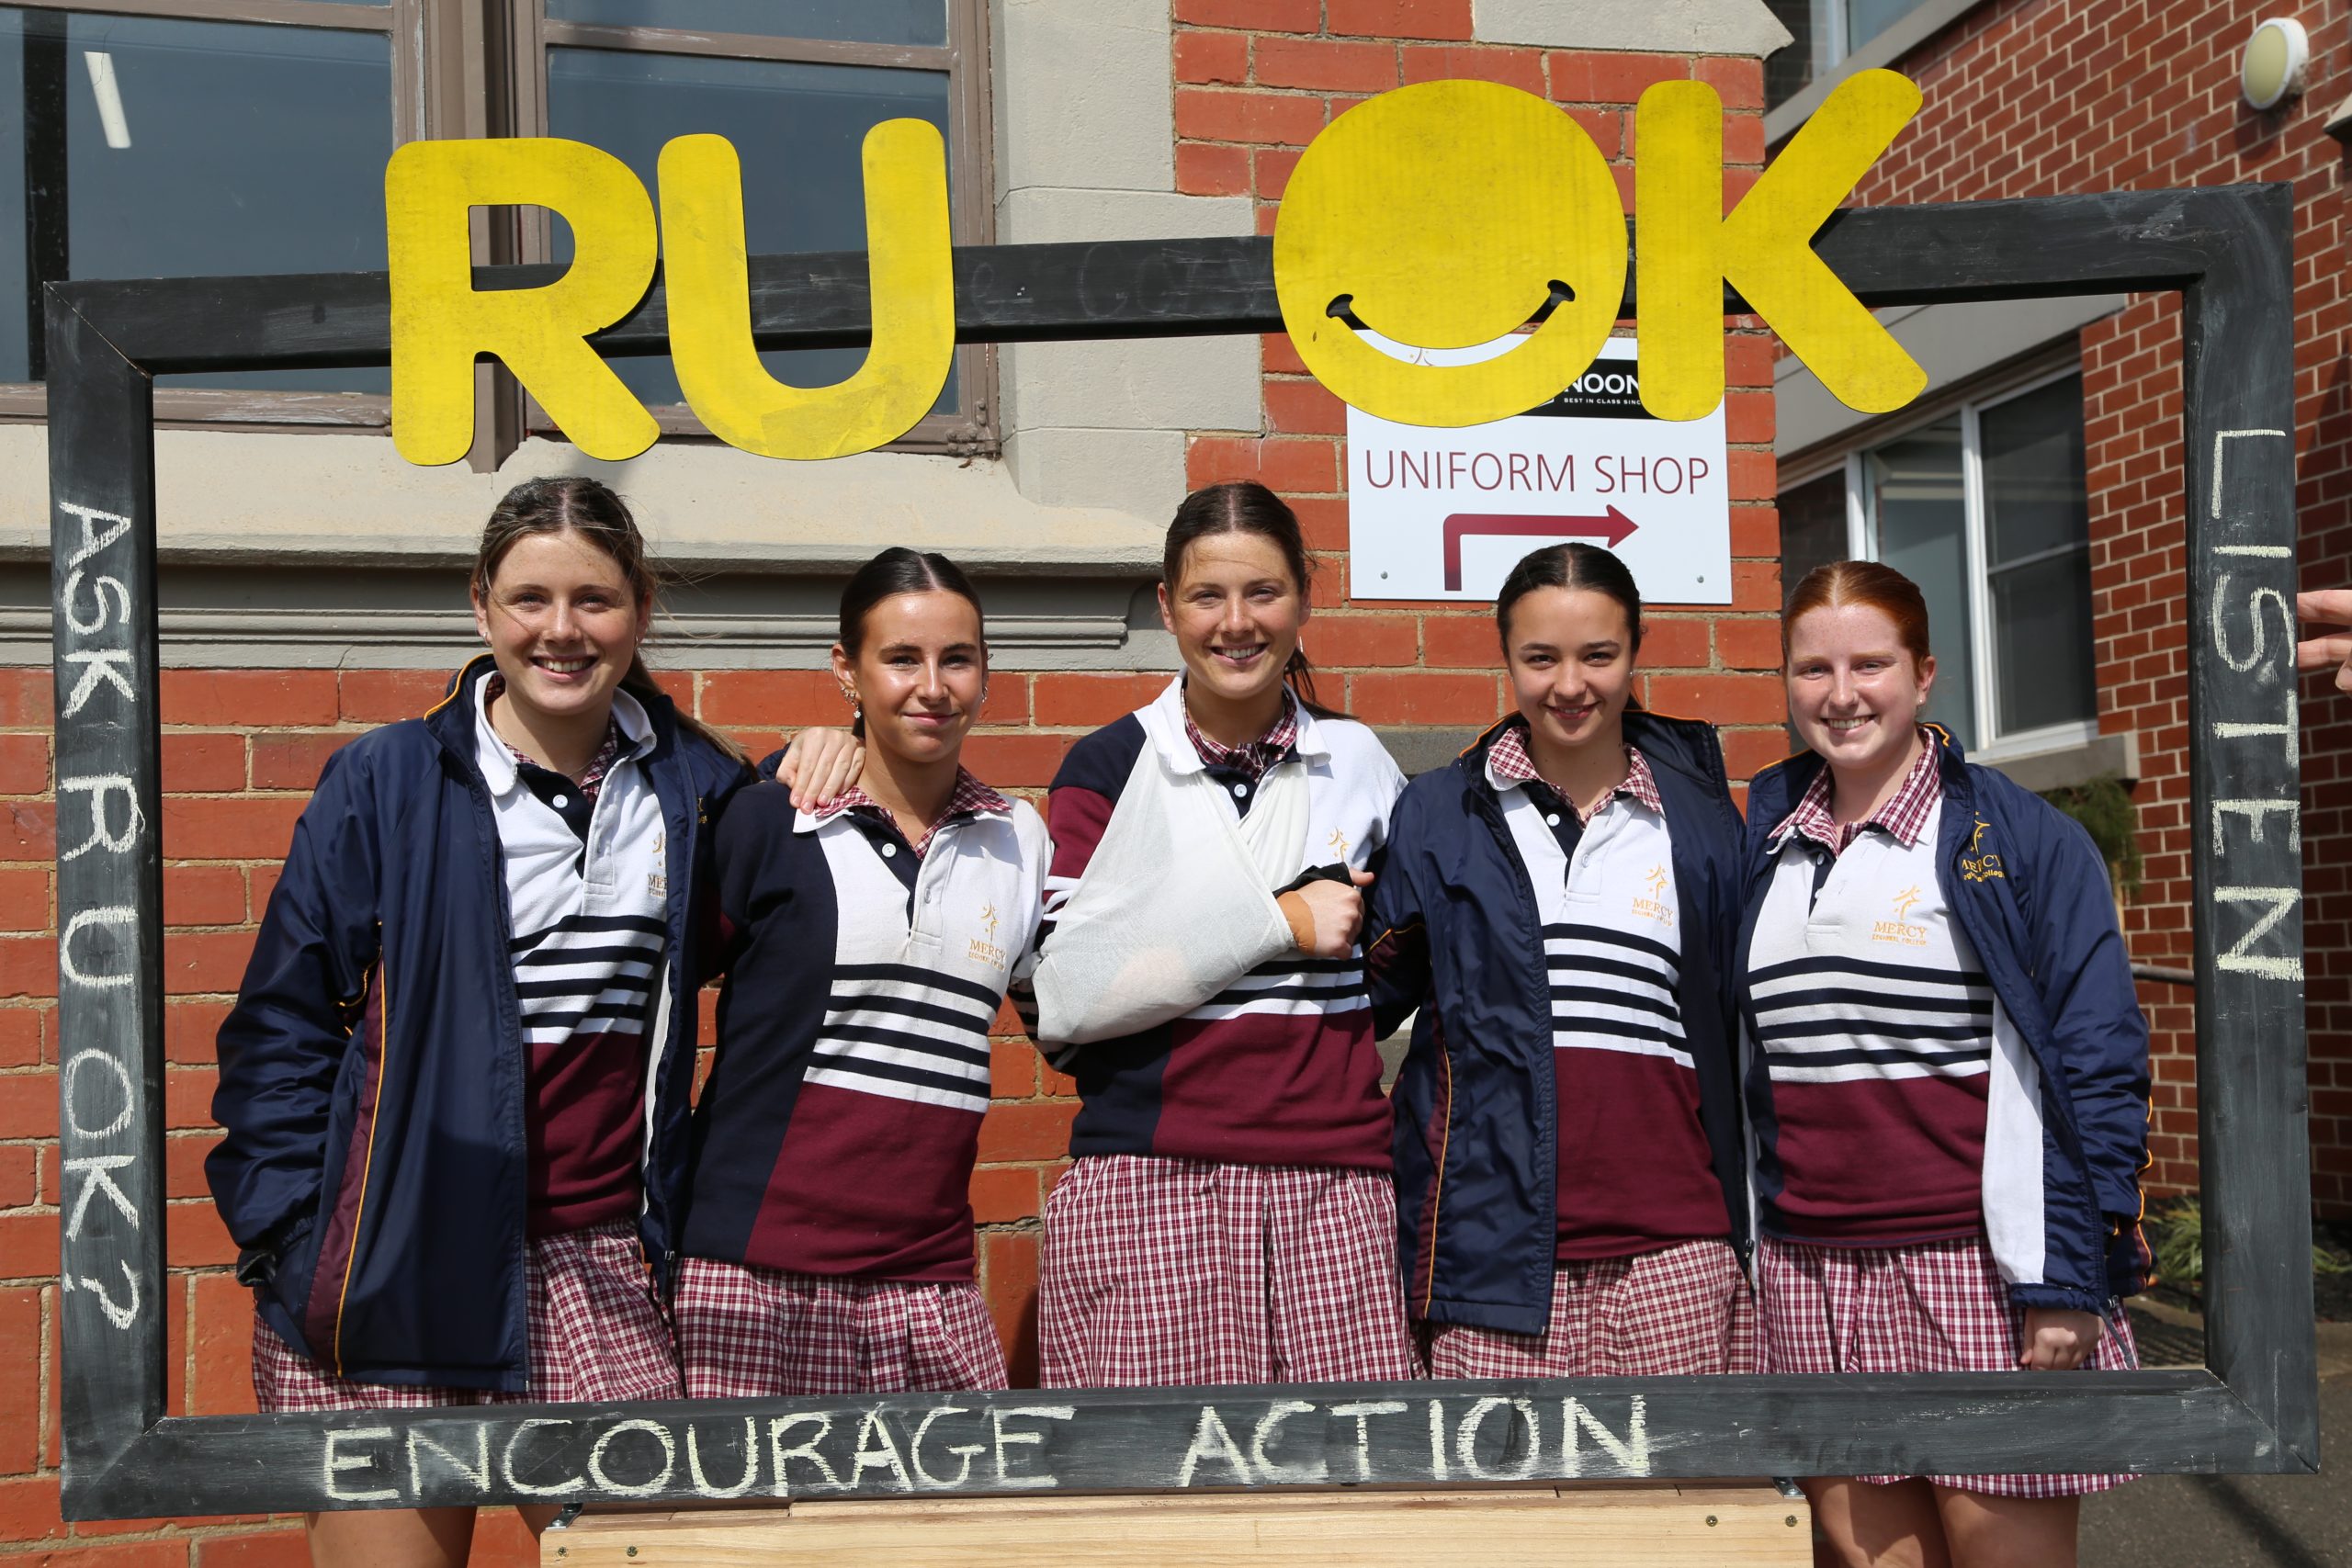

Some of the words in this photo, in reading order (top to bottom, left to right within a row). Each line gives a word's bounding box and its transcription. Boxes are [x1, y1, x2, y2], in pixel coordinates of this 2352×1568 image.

[1564, 373, 1639, 395] NOON
[1365, 449, 1576, 493] UNIFORM
[1594, 455, 1709, 495] SHOP
[59, 501, 135, 719] ASK
[2211, 428, 2304, 983] LISTEN
[1633, 897, 1674, 919] MERCY
[1874, 920, 1927, 938] MERCY
[969, 938, 1006, 963] MERCY
[322, 1405, 1077, 1501] ENCOURAGE
[1179, 1393, 1652, 1488] ACTION
